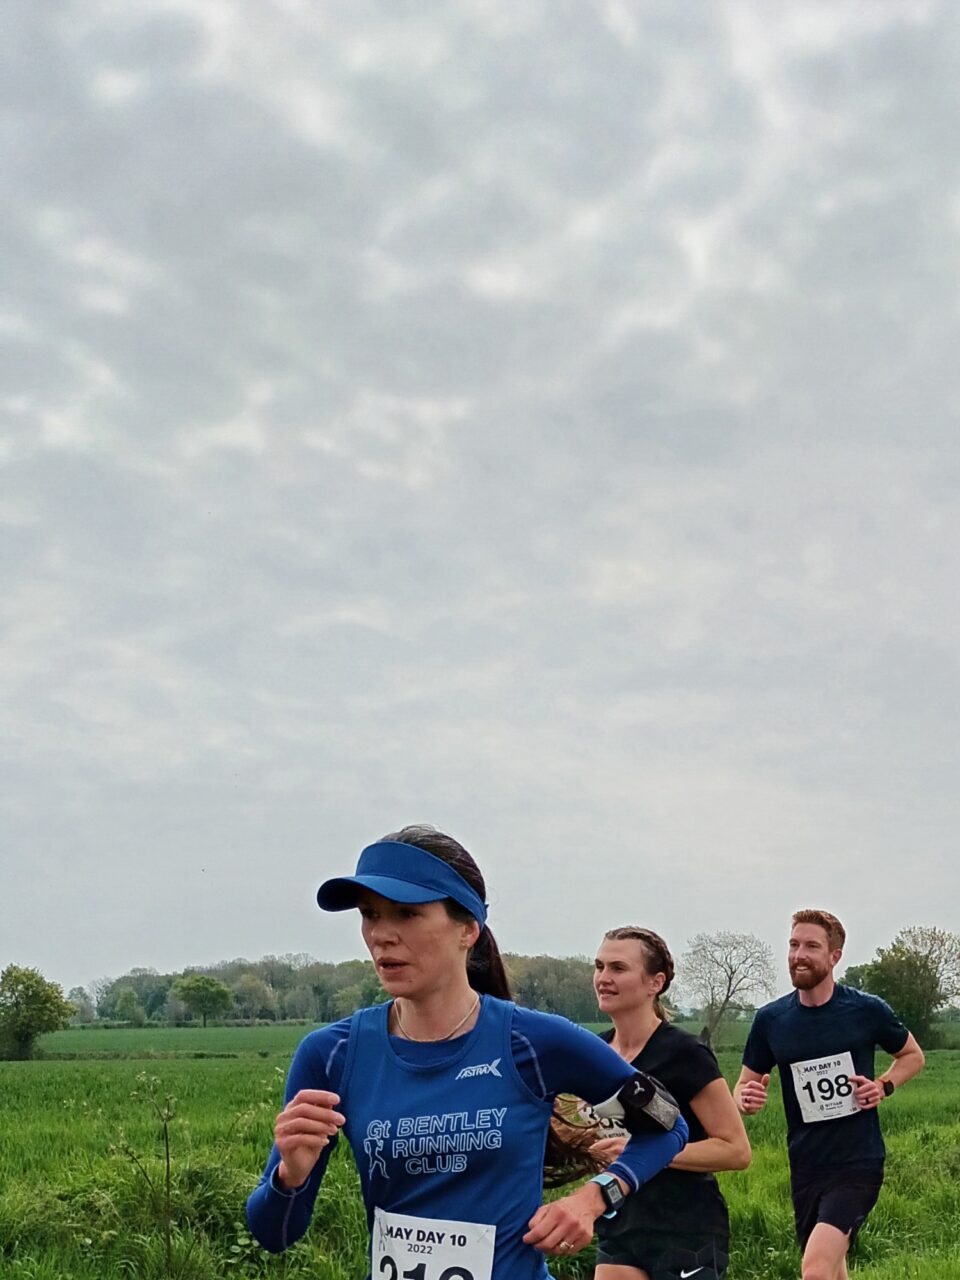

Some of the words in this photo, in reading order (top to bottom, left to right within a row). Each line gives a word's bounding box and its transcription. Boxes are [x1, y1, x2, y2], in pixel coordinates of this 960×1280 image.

[804, 1065, 817, 1073] MAY
[818, 1062, 831, 1070] DAY
[802, 1074, 852, 1103] 198
[367, 1120, 391, 1138] Gt
[397, 1108, 507, 1137] BENTLEY
[392, 1130, 502, 1158] RUNNING
[405, 1154, 467, 1174] CLUB
[386, 1225, 413, 1241] MAY
[416, 1230, 446, 1244] DAY
[450, 1234, 467, 1247] 10
[407, 1244, 433, 1255] 2022
